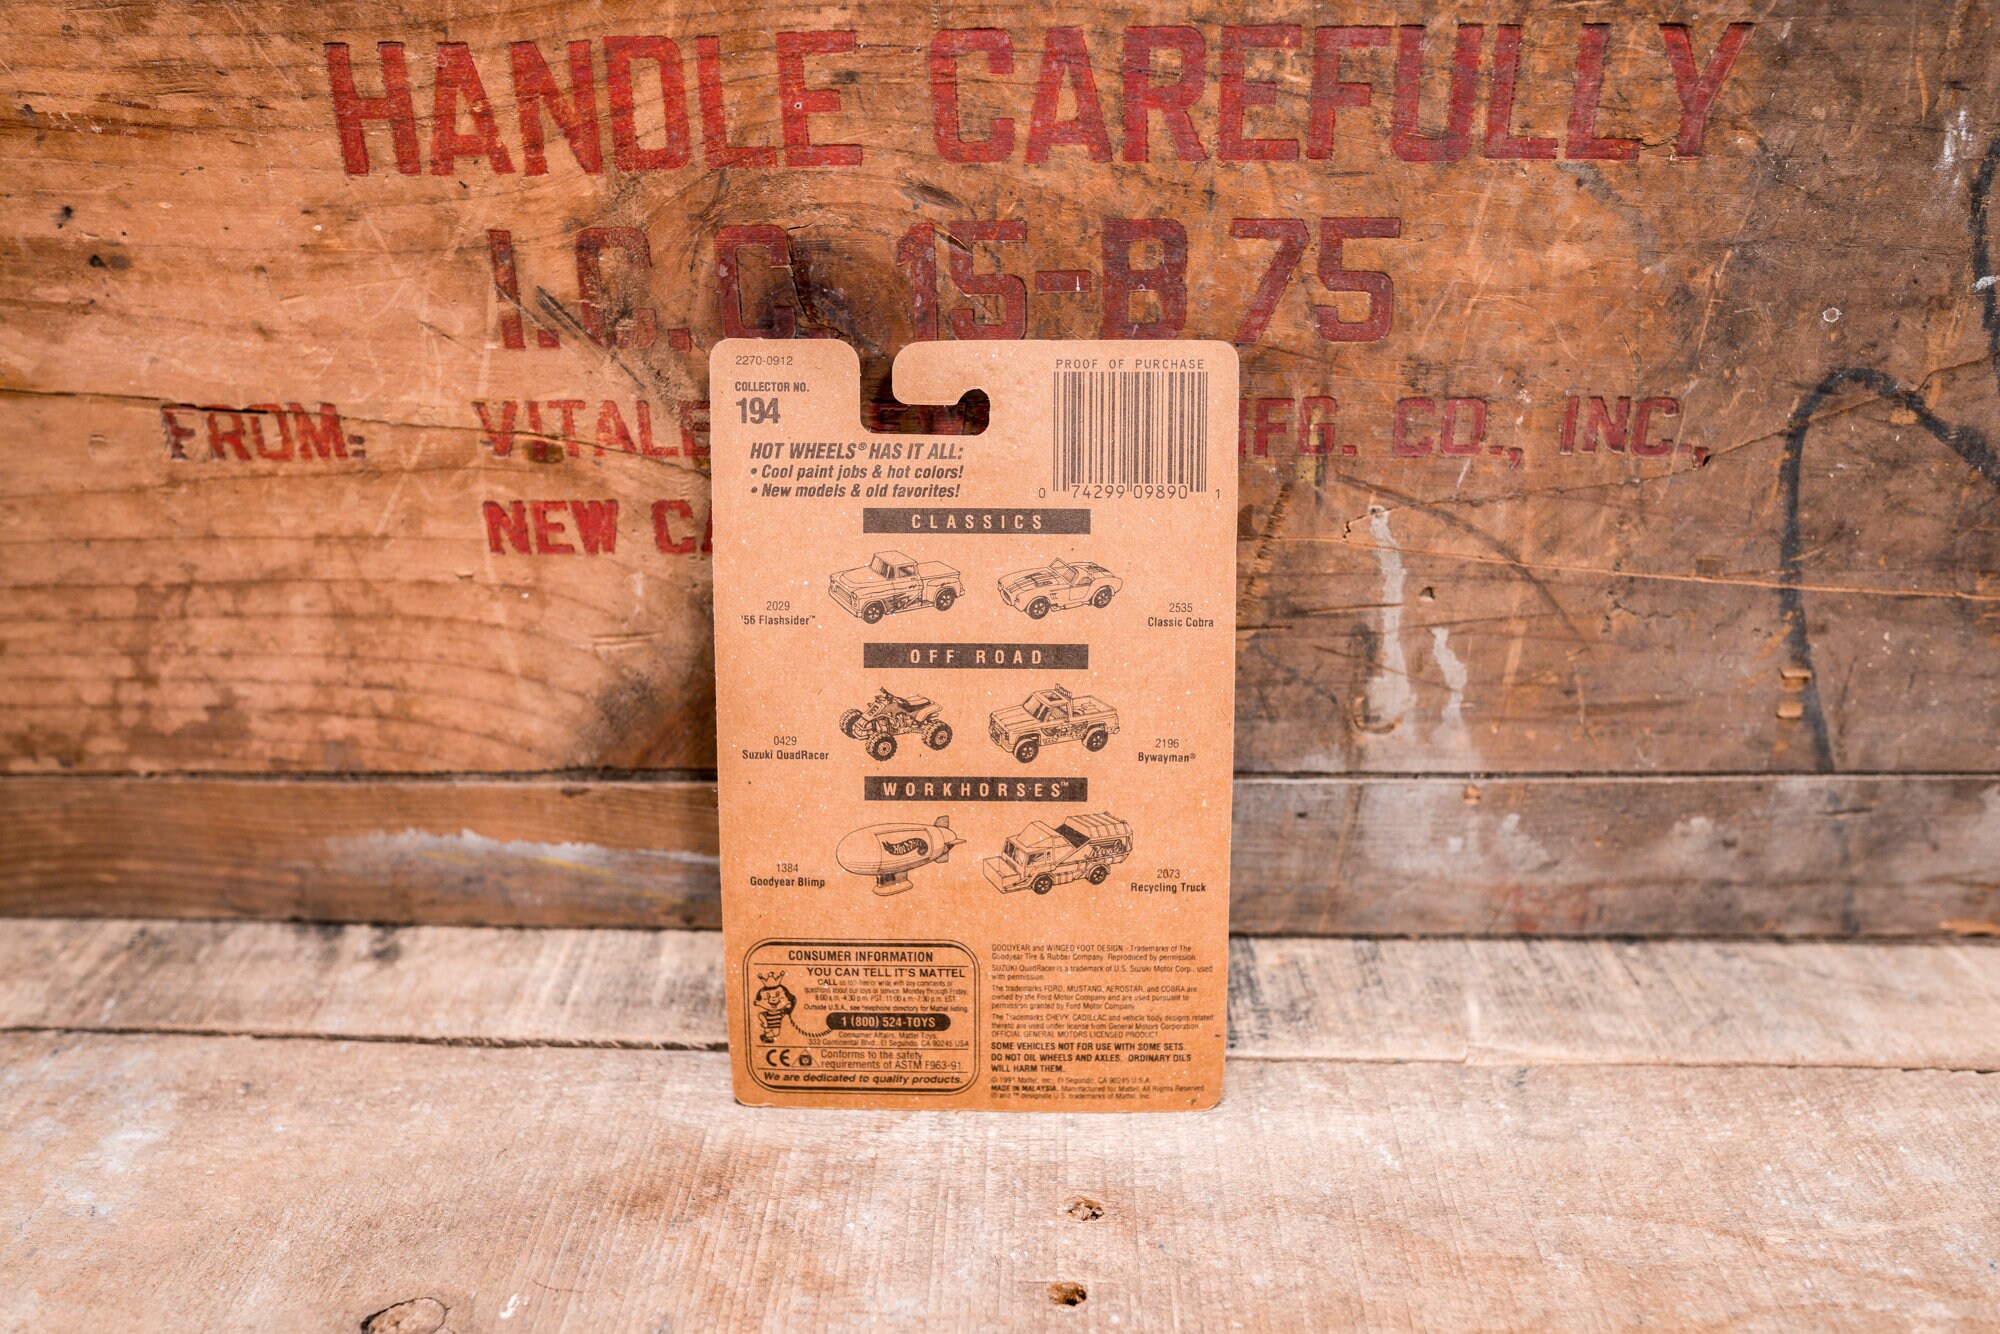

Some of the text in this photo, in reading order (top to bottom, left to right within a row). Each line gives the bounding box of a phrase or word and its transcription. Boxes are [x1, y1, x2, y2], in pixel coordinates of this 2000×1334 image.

[323, 22, 1757, 176] HANDLE CAREFULLY
[735, 355, 793, 366] 2270-0912
[1056, 359, 1204, 369] PROOF OF PURCHASE
[735, 381, 809, 392] COLLECTOR NO.
[735, 397, 781, 424] 194
[161, 402, 366, 462] FROM:
[1239, 395, 1358, 459] FG.
[1394, 397, 1524, 470] CO.,
[750, 442, 784, 460] HOT
[868, 442, 902, 460] HAS
[906, 442, 924, 460] IT
[927, 442, 963, 460] ALL:
[761, 464, 964, 481] Cool paint jobs & hot colors!
[761, 484, 960, 498] New models & old favorites!
[1072, 485, 1125, 499] 74299
[1133, 485, 1188, 499] 09890
[1215, 489, 1220, 499] 1
[482, 499, 619, 554] NEW
[912, 514, 1042, 529] CLASSICS
[766, 601, 791, 611] 2029
[1169, 602, 1193, 613] 2535
[1147, 617, 1214, 628] Classic Cobra
[911, 650, 1042, 664] OFF ROAD
[773, 736, 797, 746] 0429
[1155, 739, 1179, 749] 2196
[742, 749, 829, 760] Suzuki QuadRacer
[776, 863, 799, 873] 1384
[1156, 869, 1181, 879] 2073
[750, 876, 825, 888] Goodyear Blimp
[1130, 882, 1206, 894] Recycling Truck
[788, 950, 933, 962] CONSUMER INFORMATION
[807, 967, 966, 978] YOU CAN TELL IT'S MATTEL
[841, 1015, 936, 1028] 1 (800) 524-TOYS
[991, 1042, 1015, 1051] SOME
[1017, 1042, 1056, 1051] VEHICLES
[1058, 1042, 1075, 1051] NOT
[1077, 1042, 1094, 1051] FOR
[1096, 1042, 1112, 1051] USE
[1114, 1042, 1135, 1051] WITH
[1137, 1042, 1162, 1051] SOME
[821, 1050, 922, 1061] Conforms to the safety
[991, 1054, 1003, 1062] DO
[1005, 1054, 1022, 1062] NOT
[1023, 1054, 1037, 1062] OIL
[1039, 1054, 1073, 1062] WHEELS
[1075, 1054, 1092, 1062] AND
[1128, 1054, 1171, 1062] ORDINARY
[1172, 1054, 1191, 1062] OILS
[821, 1060, 881, 1071] requirements
[882, 1061, 893, 1070] of
[894, 1061, 922, 1070] ASTM
[764, 1072, 780, 1081] We
[803, 1073, 856, 1082] dedicated
[859, 1073, 870, 1082] to
[872, 1073, 909, 1085] quality
[911, 1074, 963, 1085] products.
